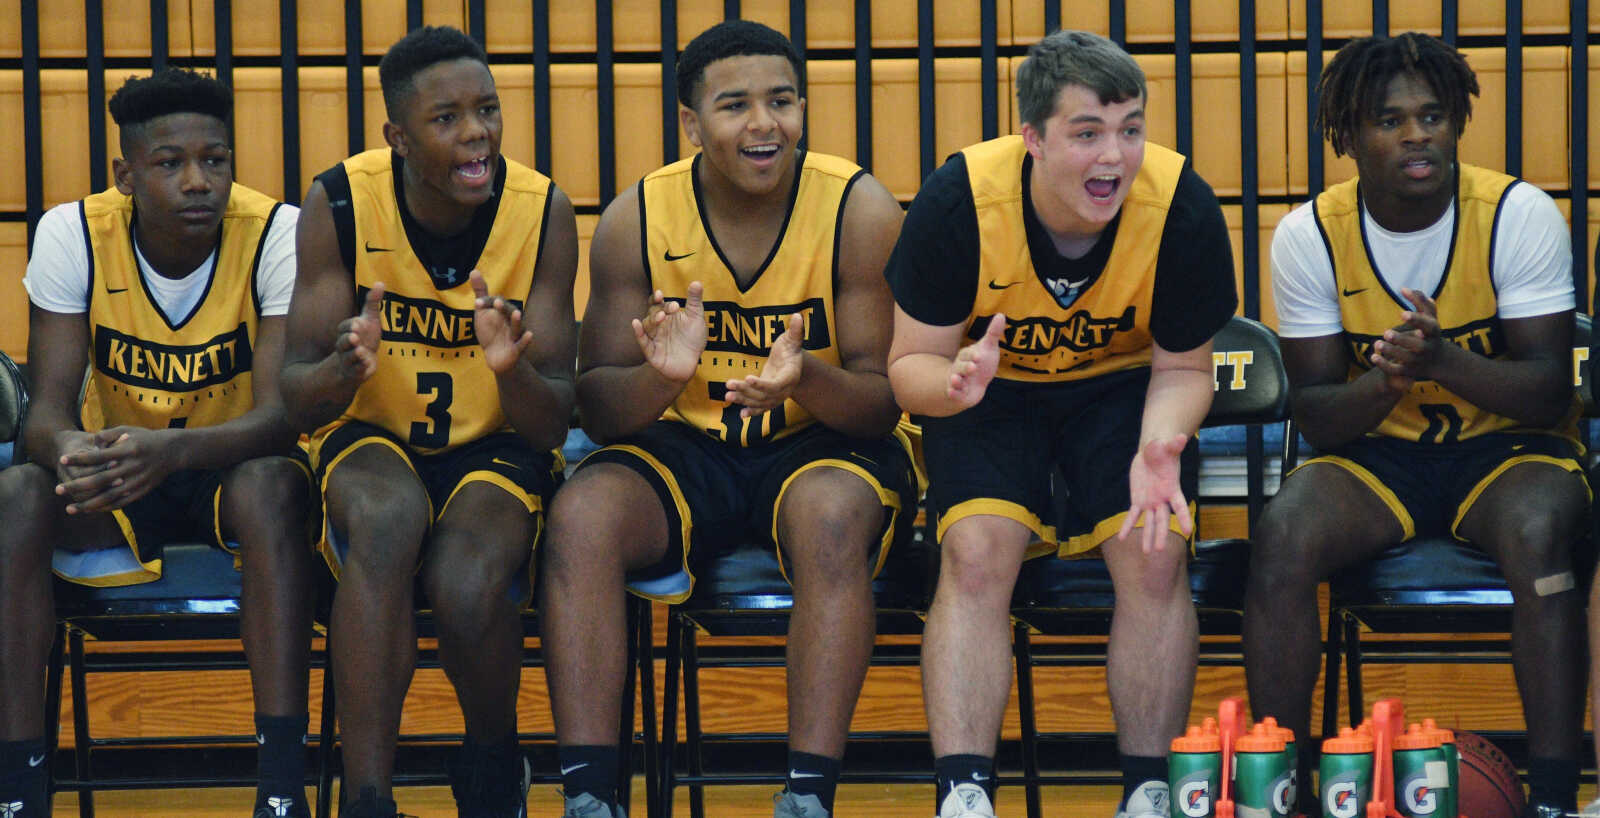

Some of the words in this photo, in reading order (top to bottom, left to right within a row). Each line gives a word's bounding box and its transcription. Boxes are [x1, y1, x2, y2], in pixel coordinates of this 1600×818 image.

[380, 299, 473, 343] ENNE
[704, 307, 814, 349] ENNET
[998, 315, 1118, 350] ENNET
[108, 338, 237, 384] KENNETT
[409, 372, 453, 449] 3
[1179, 780, 1210, 818] G
[1327, 781, 1358, 818] G
